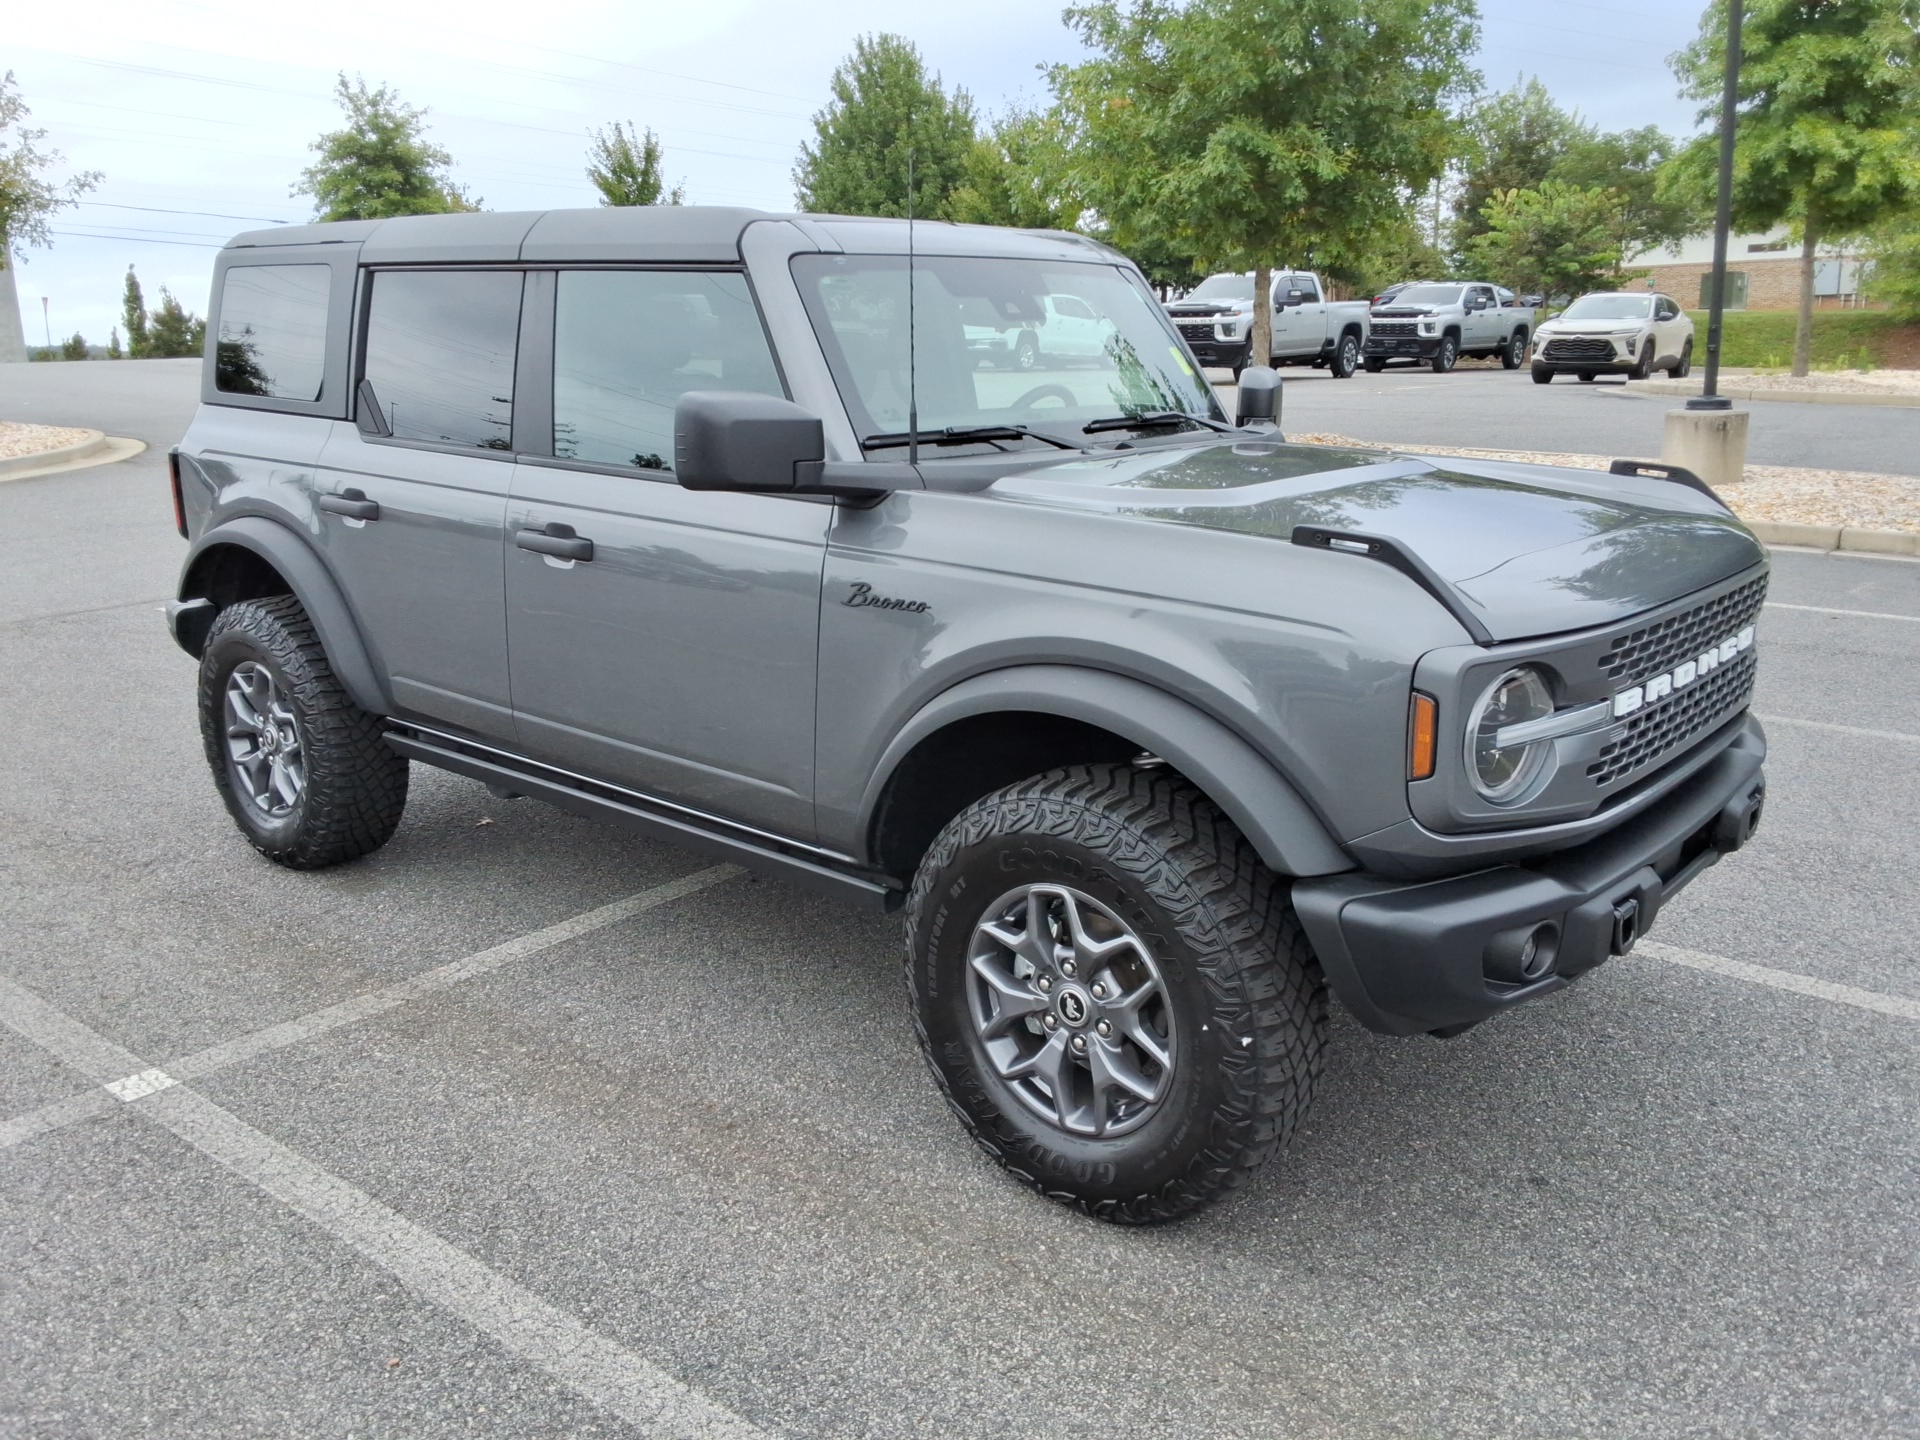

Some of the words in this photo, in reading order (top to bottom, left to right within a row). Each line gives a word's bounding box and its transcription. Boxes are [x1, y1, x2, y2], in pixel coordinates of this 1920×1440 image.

[840, 582, 932, 613] Bronco
[1614, 626, 1754, 716] BRONCO
[928, 904, 949, 998] TERRITORY
